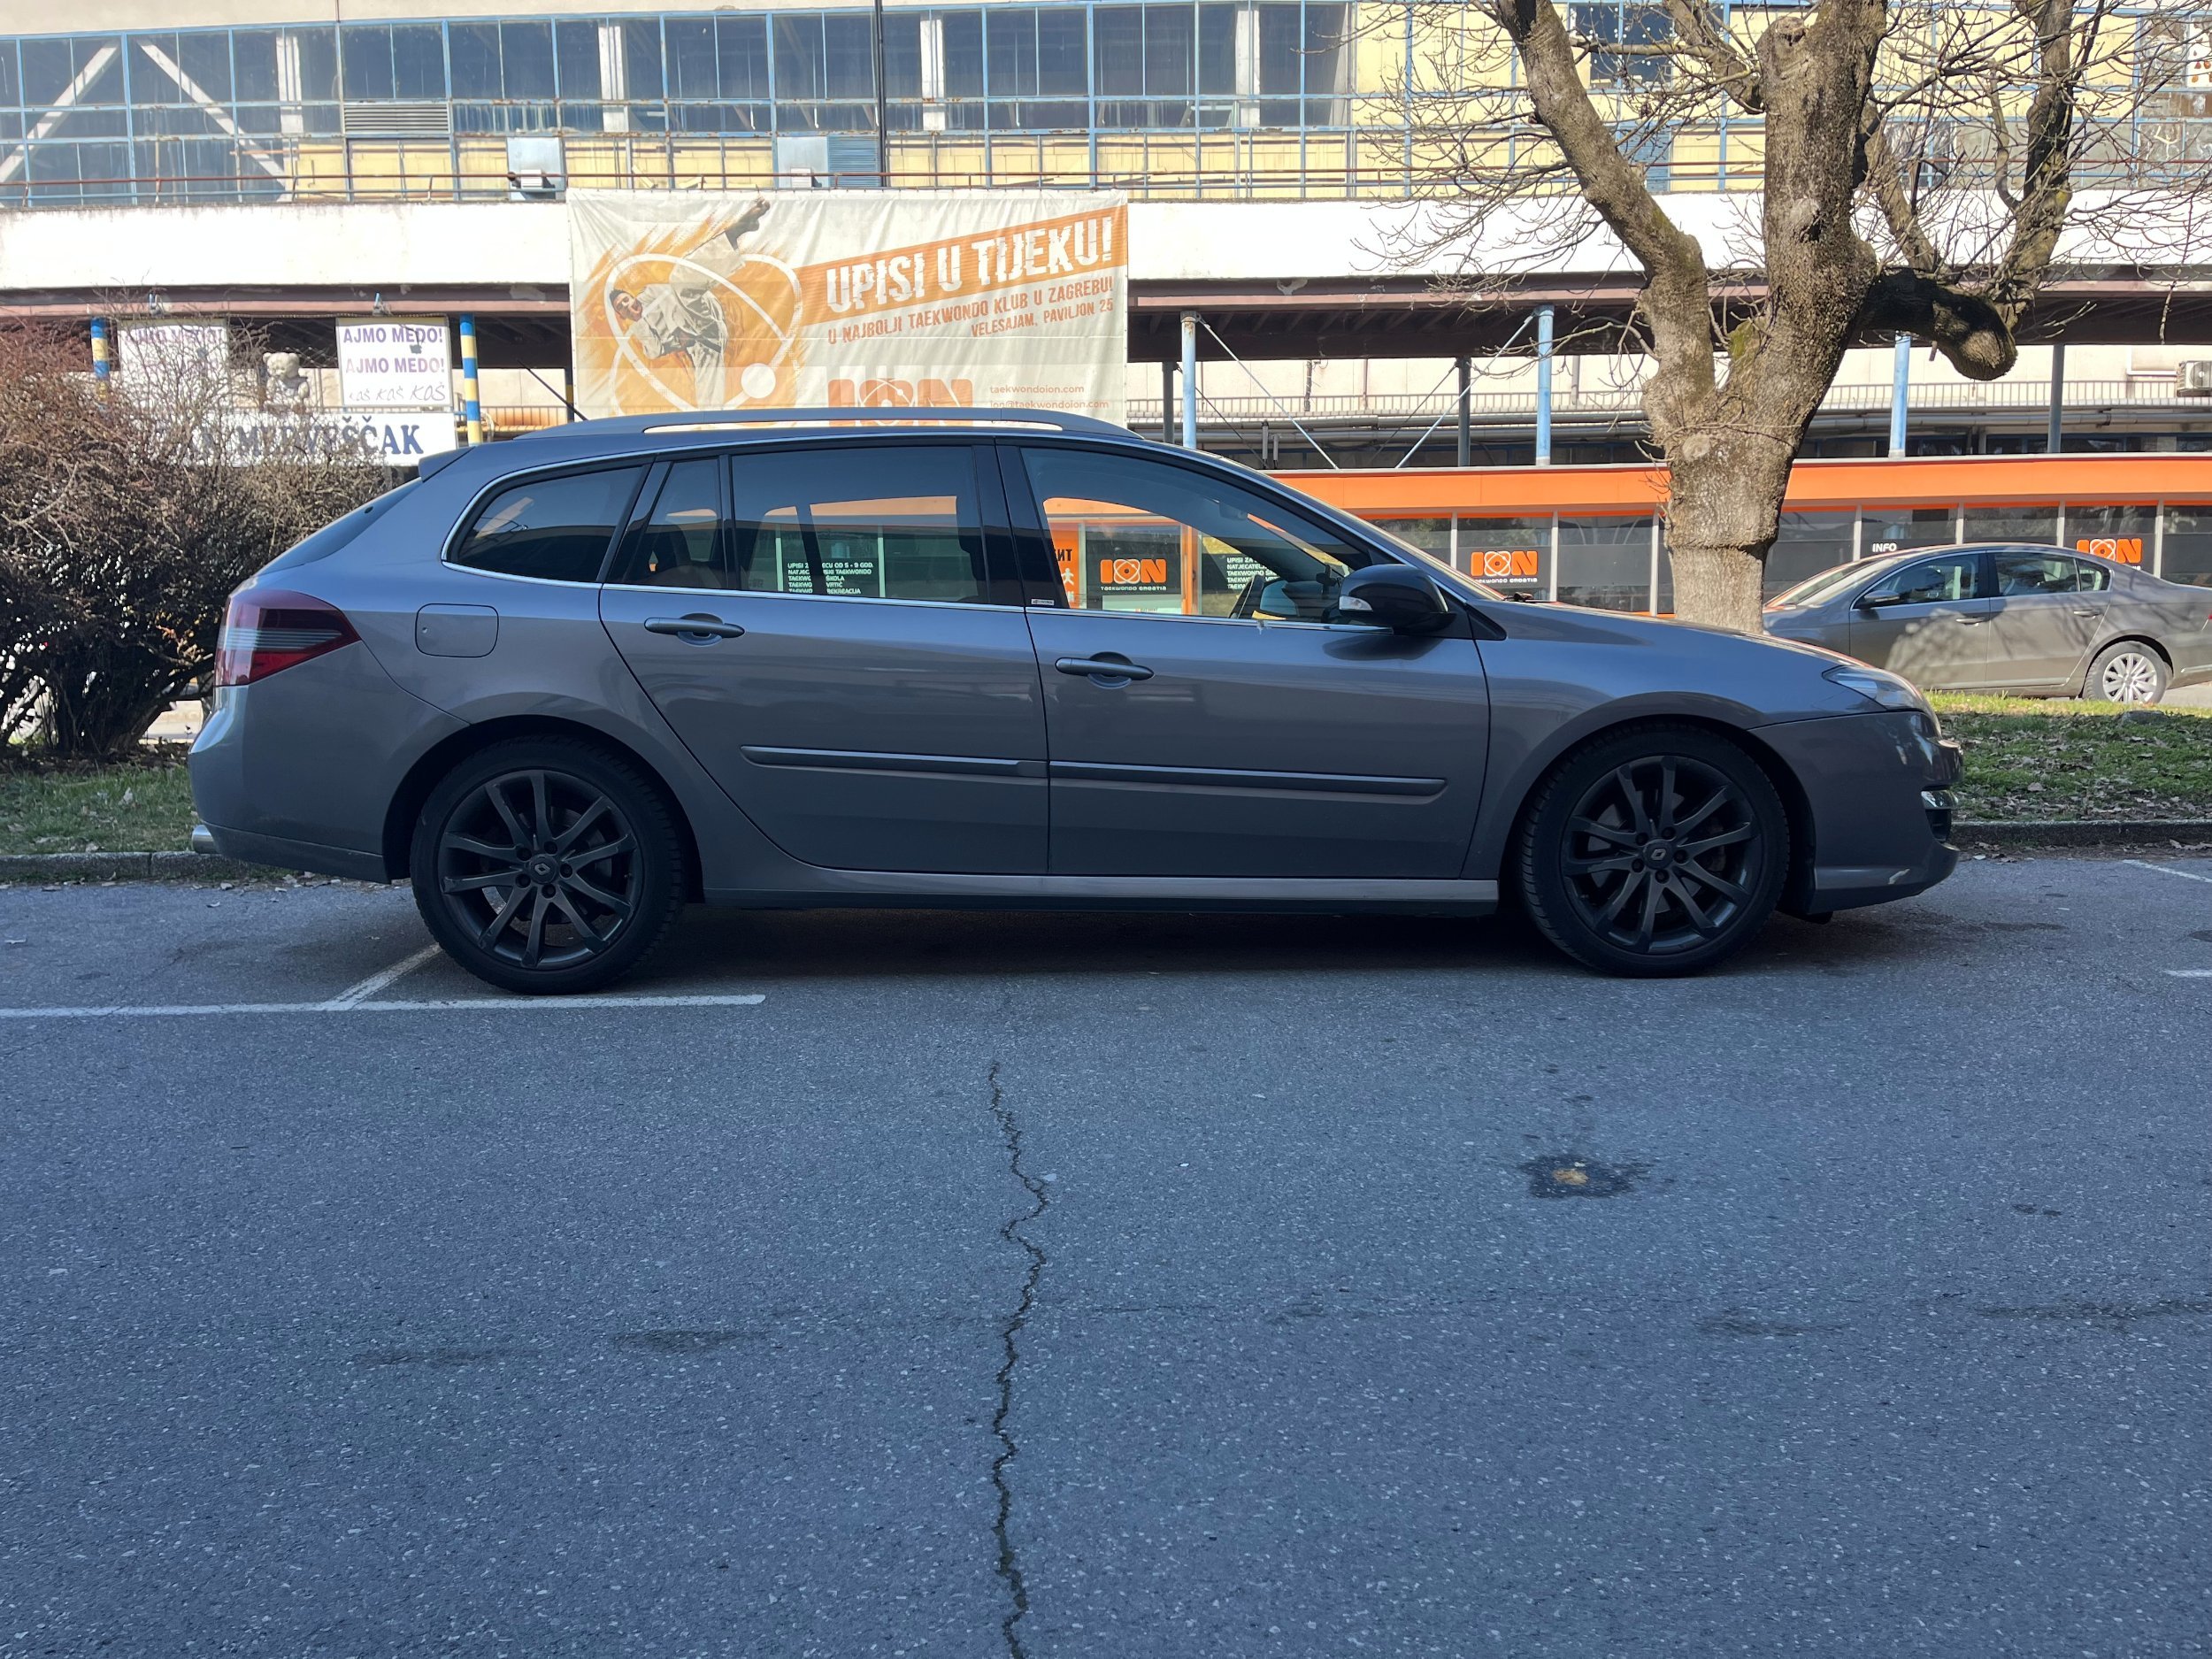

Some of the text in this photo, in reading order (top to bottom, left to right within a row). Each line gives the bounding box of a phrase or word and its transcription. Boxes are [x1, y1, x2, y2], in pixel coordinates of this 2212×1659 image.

[826, 217, 1112, 313] UPISI U TIJEKU!
[828, 276, 1113, 344] U NAJBOLJI TAEKWONDO KLUB U ZAGREBU!
[972, 298, 1114, 337] VELESAJAM, PAVILJON 25
[343, 327, 443, 343] AJMO MEDO!
[345, 357, 445, 373] AJMO MEDO!
[410, 381, 446, 402] KOŠ
[990, 384, 1085, 394] taekwondoion.com
[990, 399, 1110, 410] ion@taekwondoion.com
[1872, 542, 1897, 553] INFO
[2076, 538, 2142, 564] ION
[1100, 558, 1167, 584] ION
[1471, 550, 1538, 577] ION
